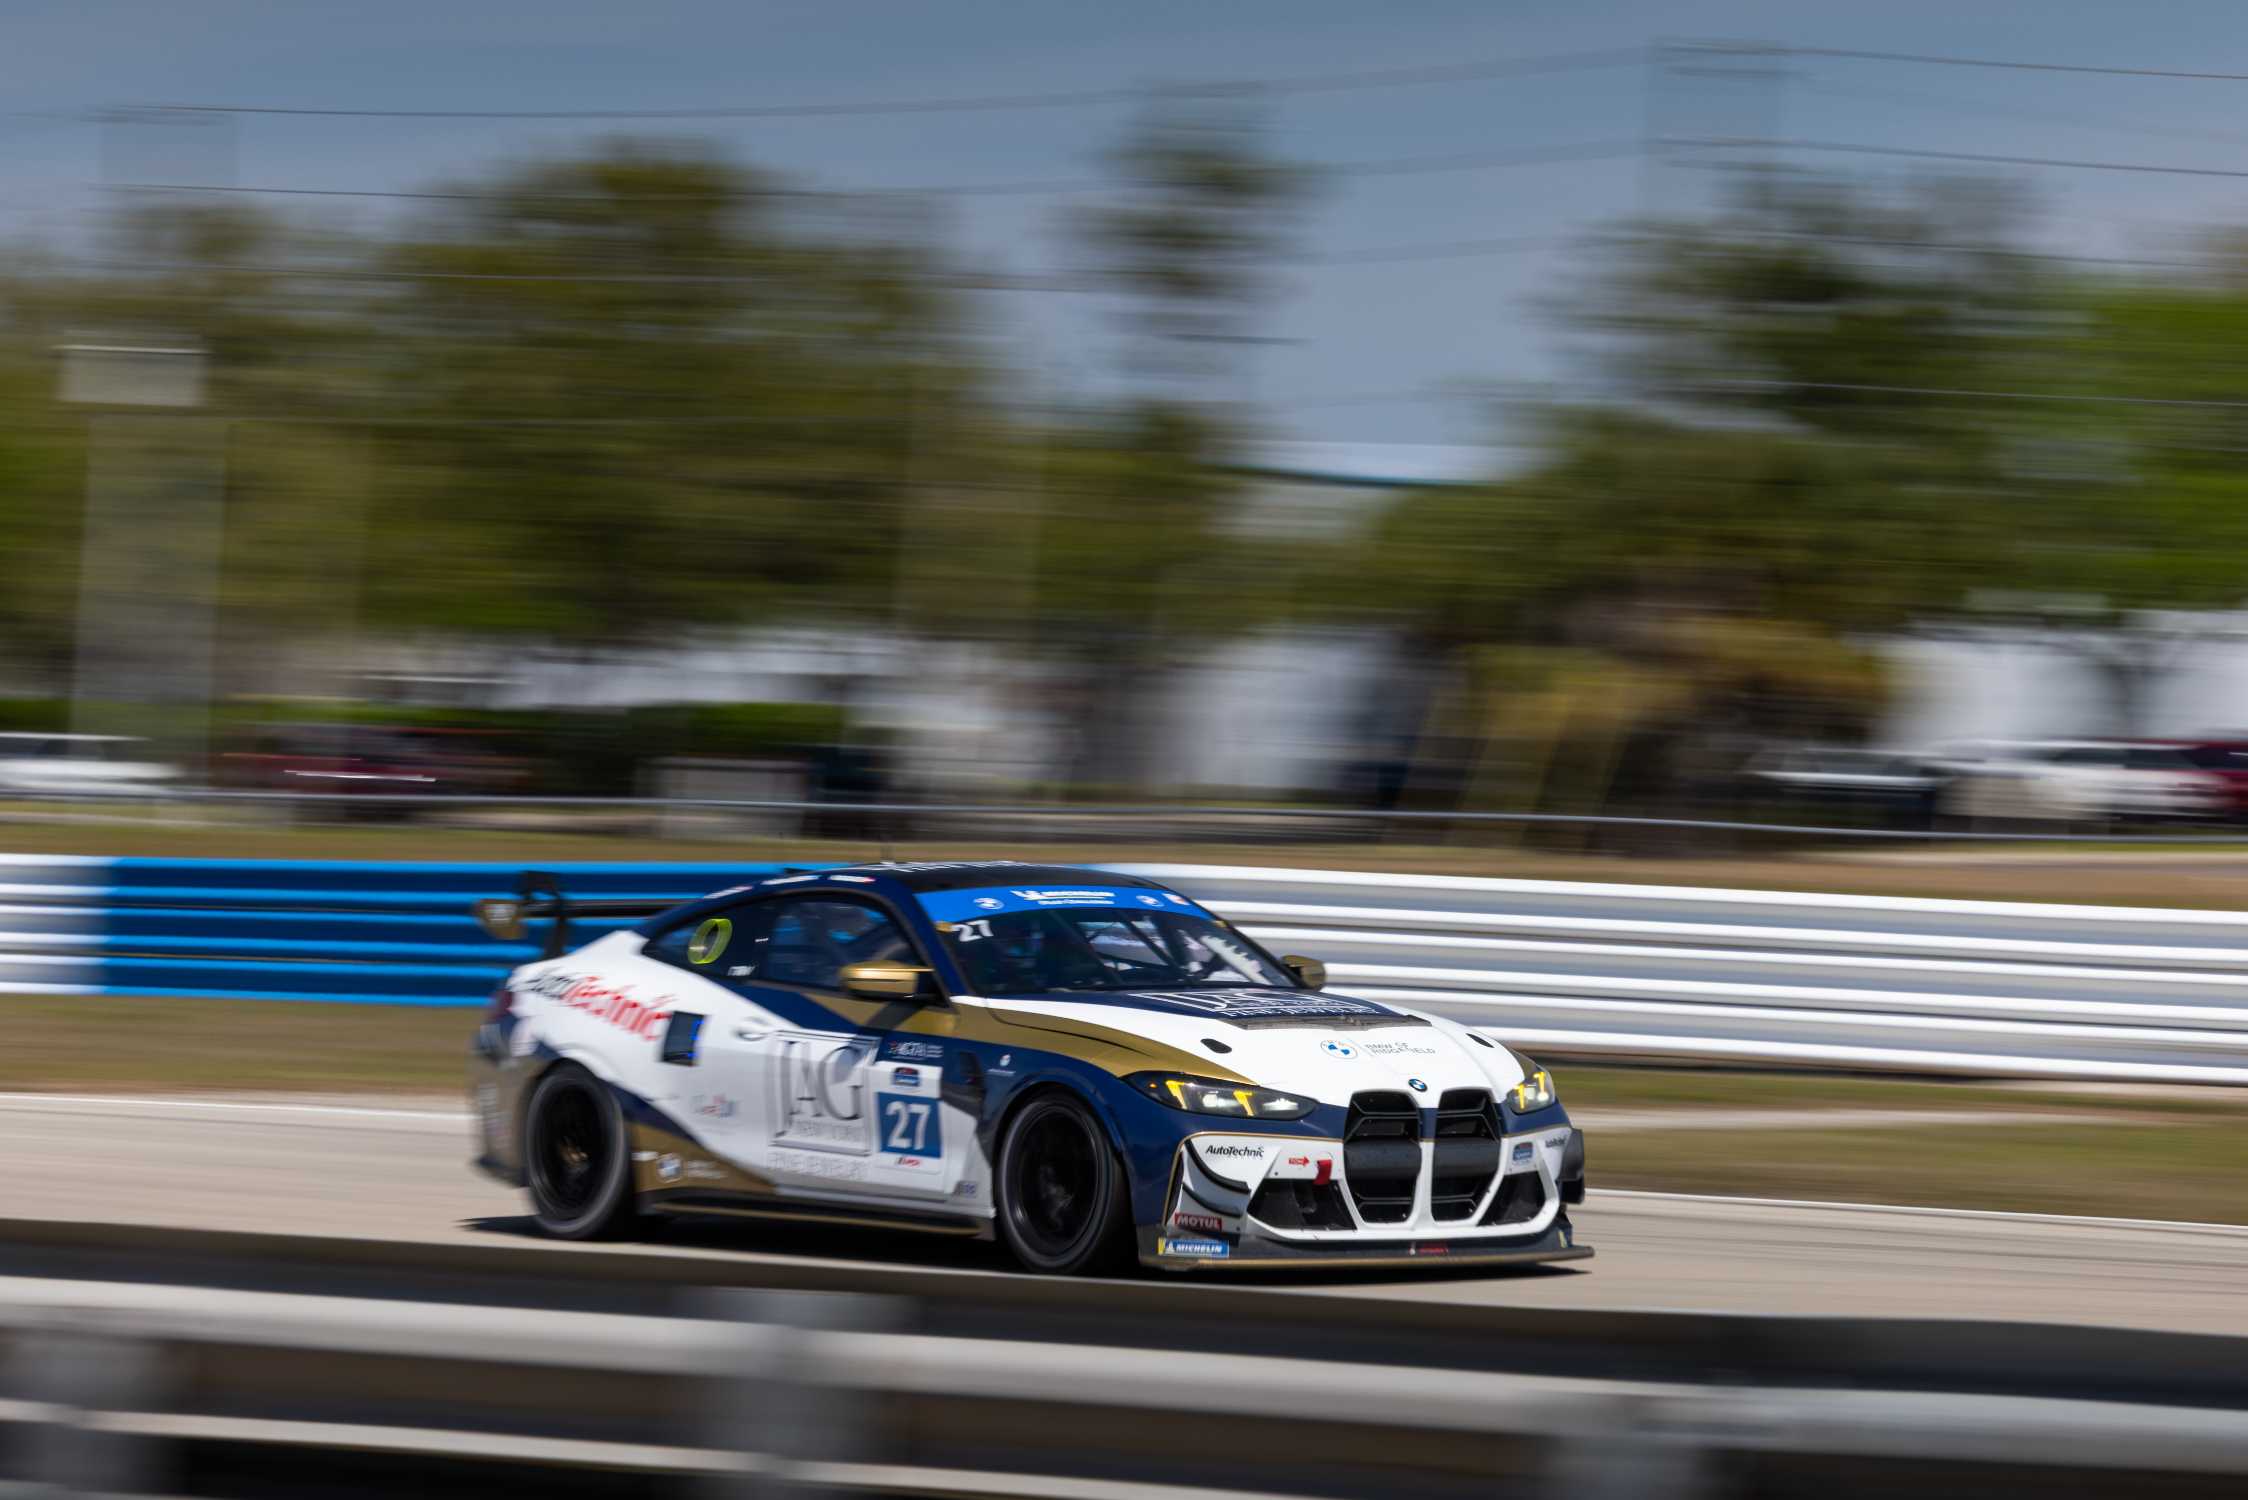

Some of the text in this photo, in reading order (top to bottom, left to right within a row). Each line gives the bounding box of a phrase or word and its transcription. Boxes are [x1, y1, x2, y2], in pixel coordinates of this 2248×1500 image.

[951, 919, 994, 943] 27
[885, 1100, 931, 1150] 27
[1205, 1145, 1265, 1158] AutoTechnic
[1177, 1215, 1221, 1229] MOTUL
[1176, 1243, 1223, 1253] MICHELIN
